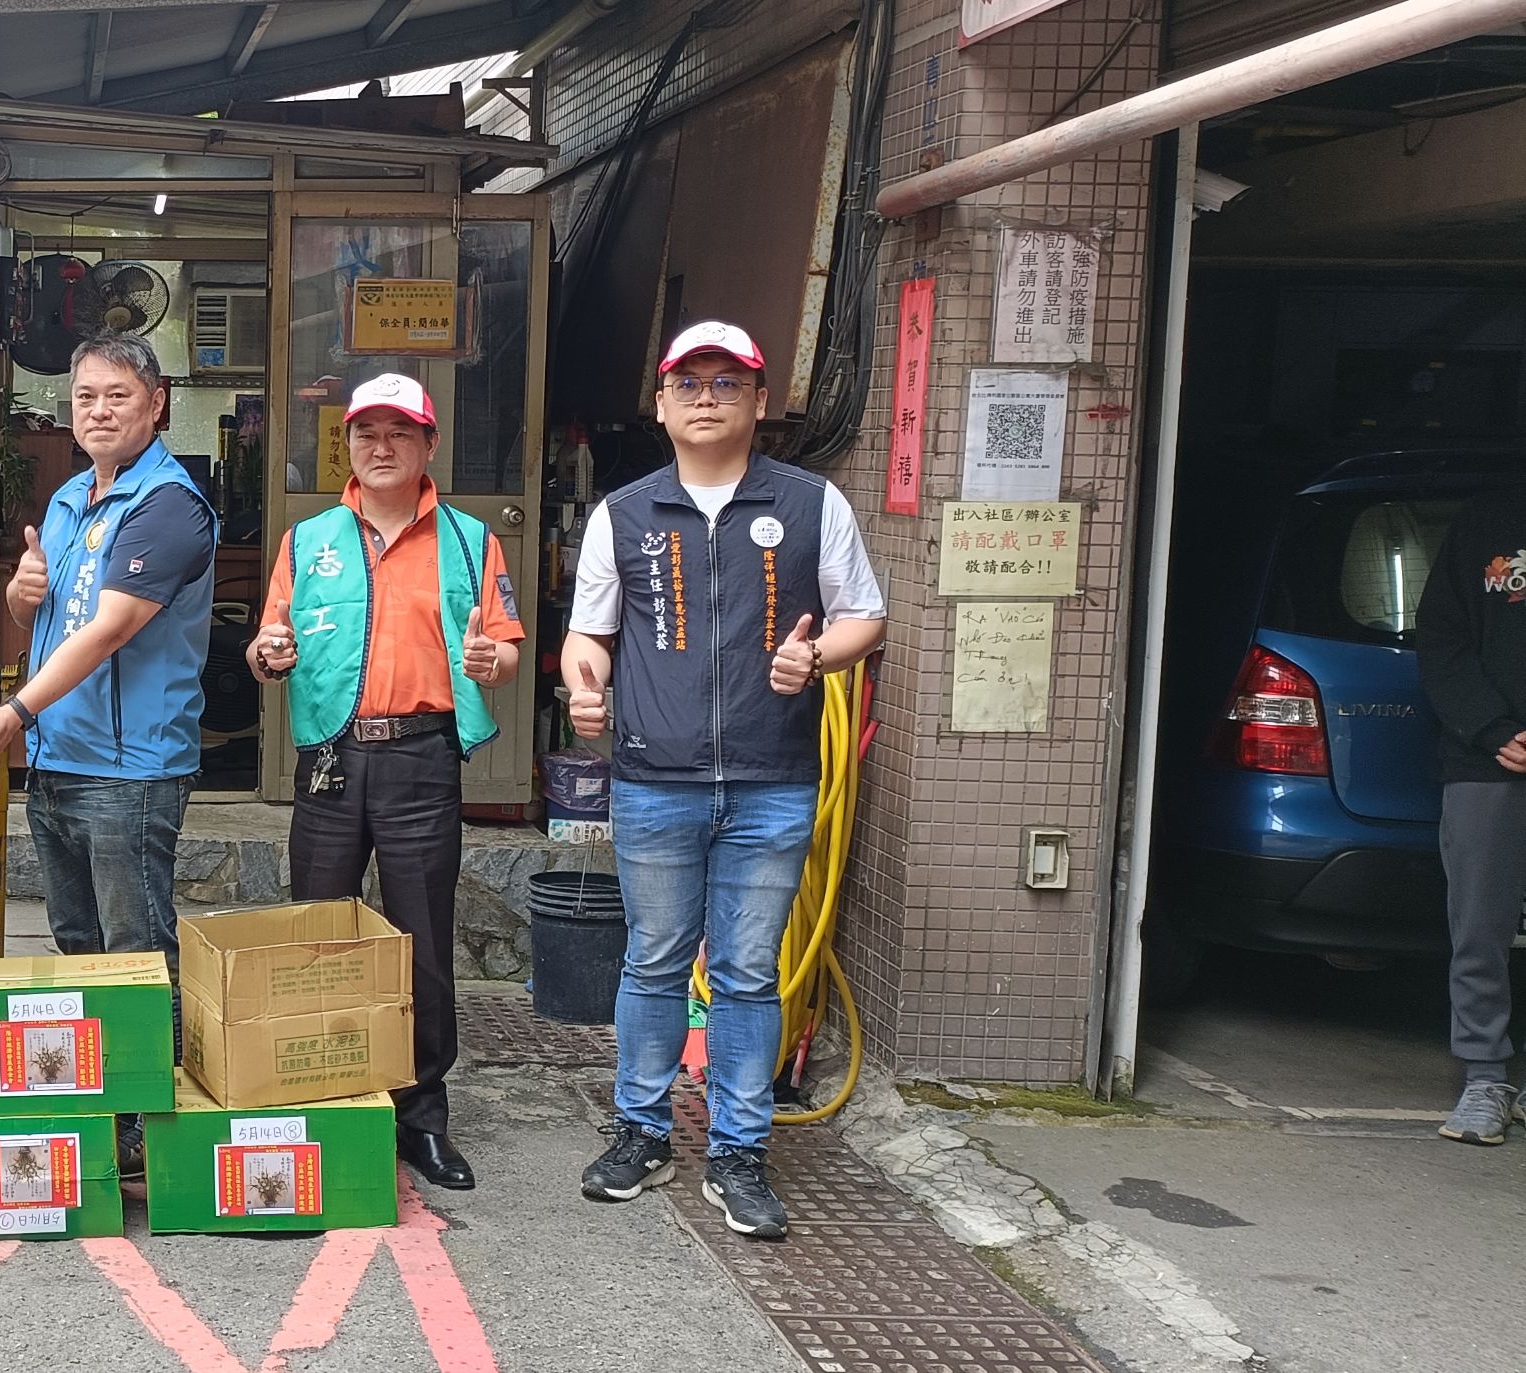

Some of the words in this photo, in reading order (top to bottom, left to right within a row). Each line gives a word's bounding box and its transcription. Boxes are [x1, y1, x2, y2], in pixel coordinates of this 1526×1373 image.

[1014, 231, 1040, 345] 外車請勿進出
[1042, 232, 1066, 326] 訪客請登記
[897, 311, 924, 487] 恭賀新禧
[327, 425, 342, 478] 請勿進入
[950, 530, 1070, 551] 請配戴口罩
[302, 542, 345, 636] 志工
[1338, 703, 1416, 718] LIVINA
